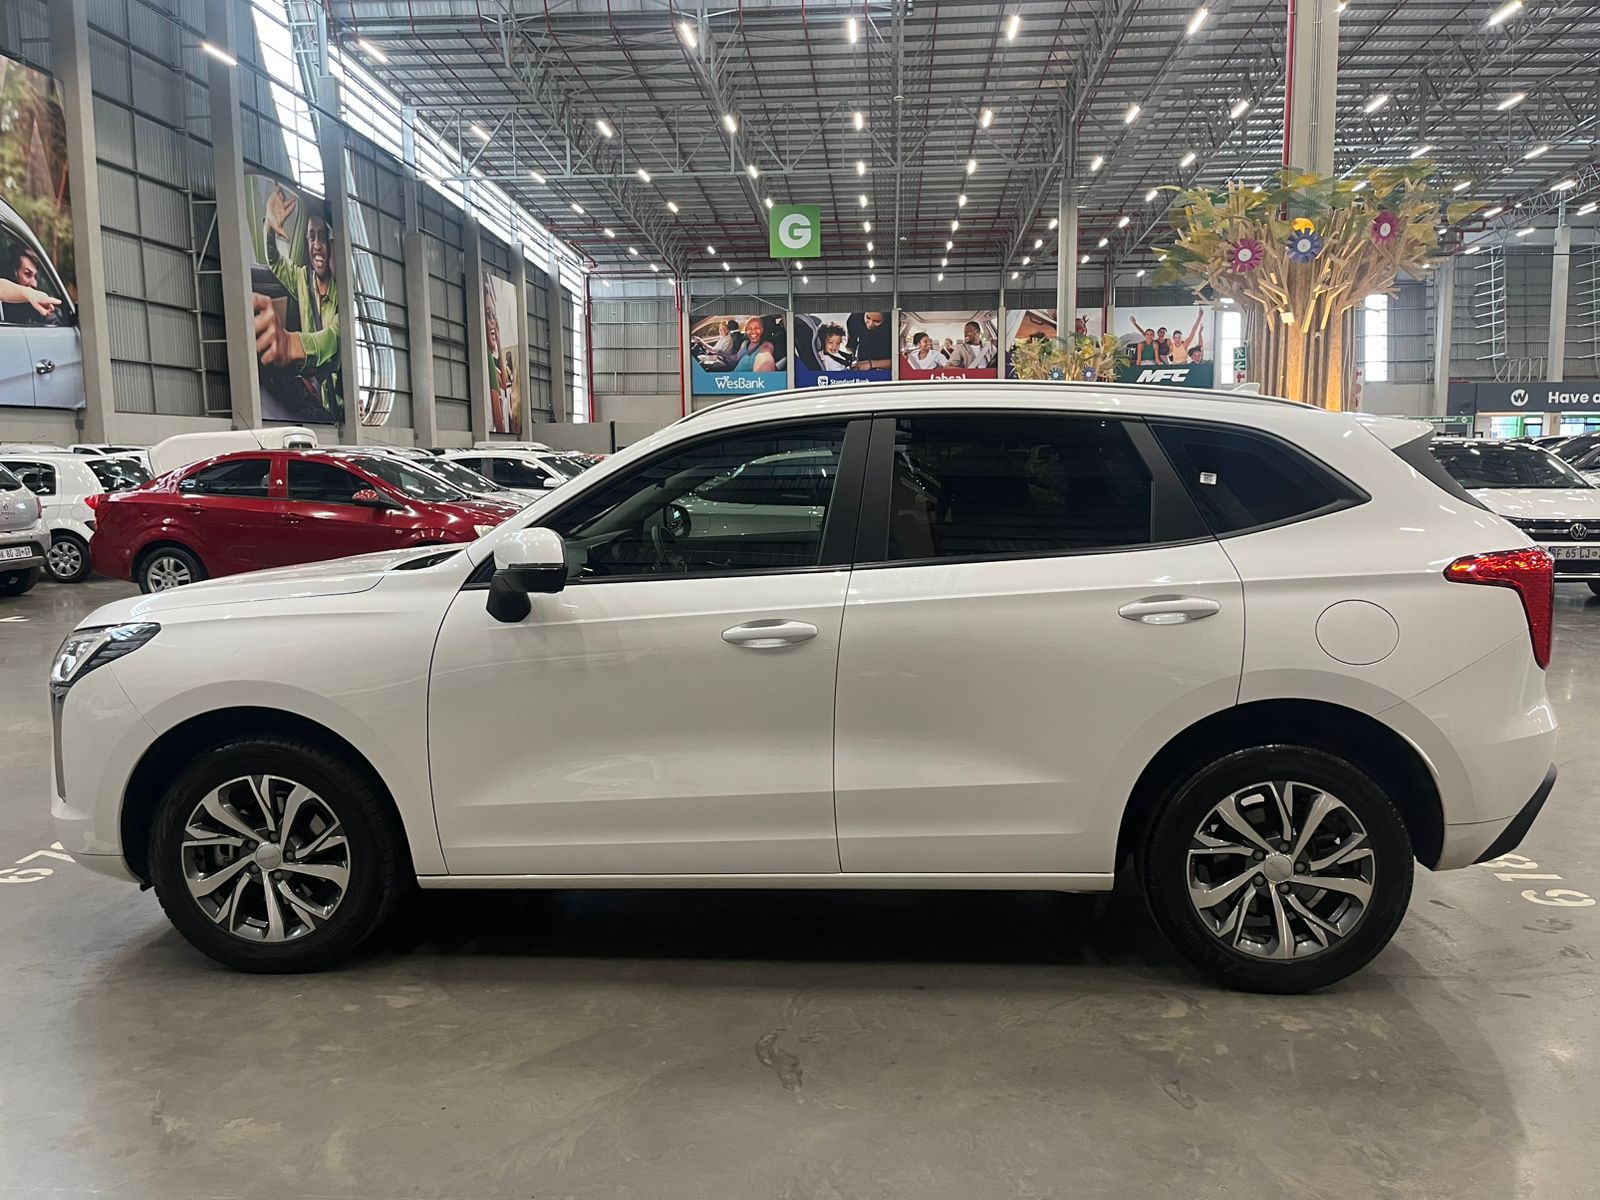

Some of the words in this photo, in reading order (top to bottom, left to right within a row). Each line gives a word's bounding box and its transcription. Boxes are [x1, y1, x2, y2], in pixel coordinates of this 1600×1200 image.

[779, 213, 812, 249] G
[715, 375, 765, 389] WesBank
[1136, 369, 1190, 383] MFC
[1548, 391, 1589, 404] Have
[1565, 549, 1576, 558] 65
